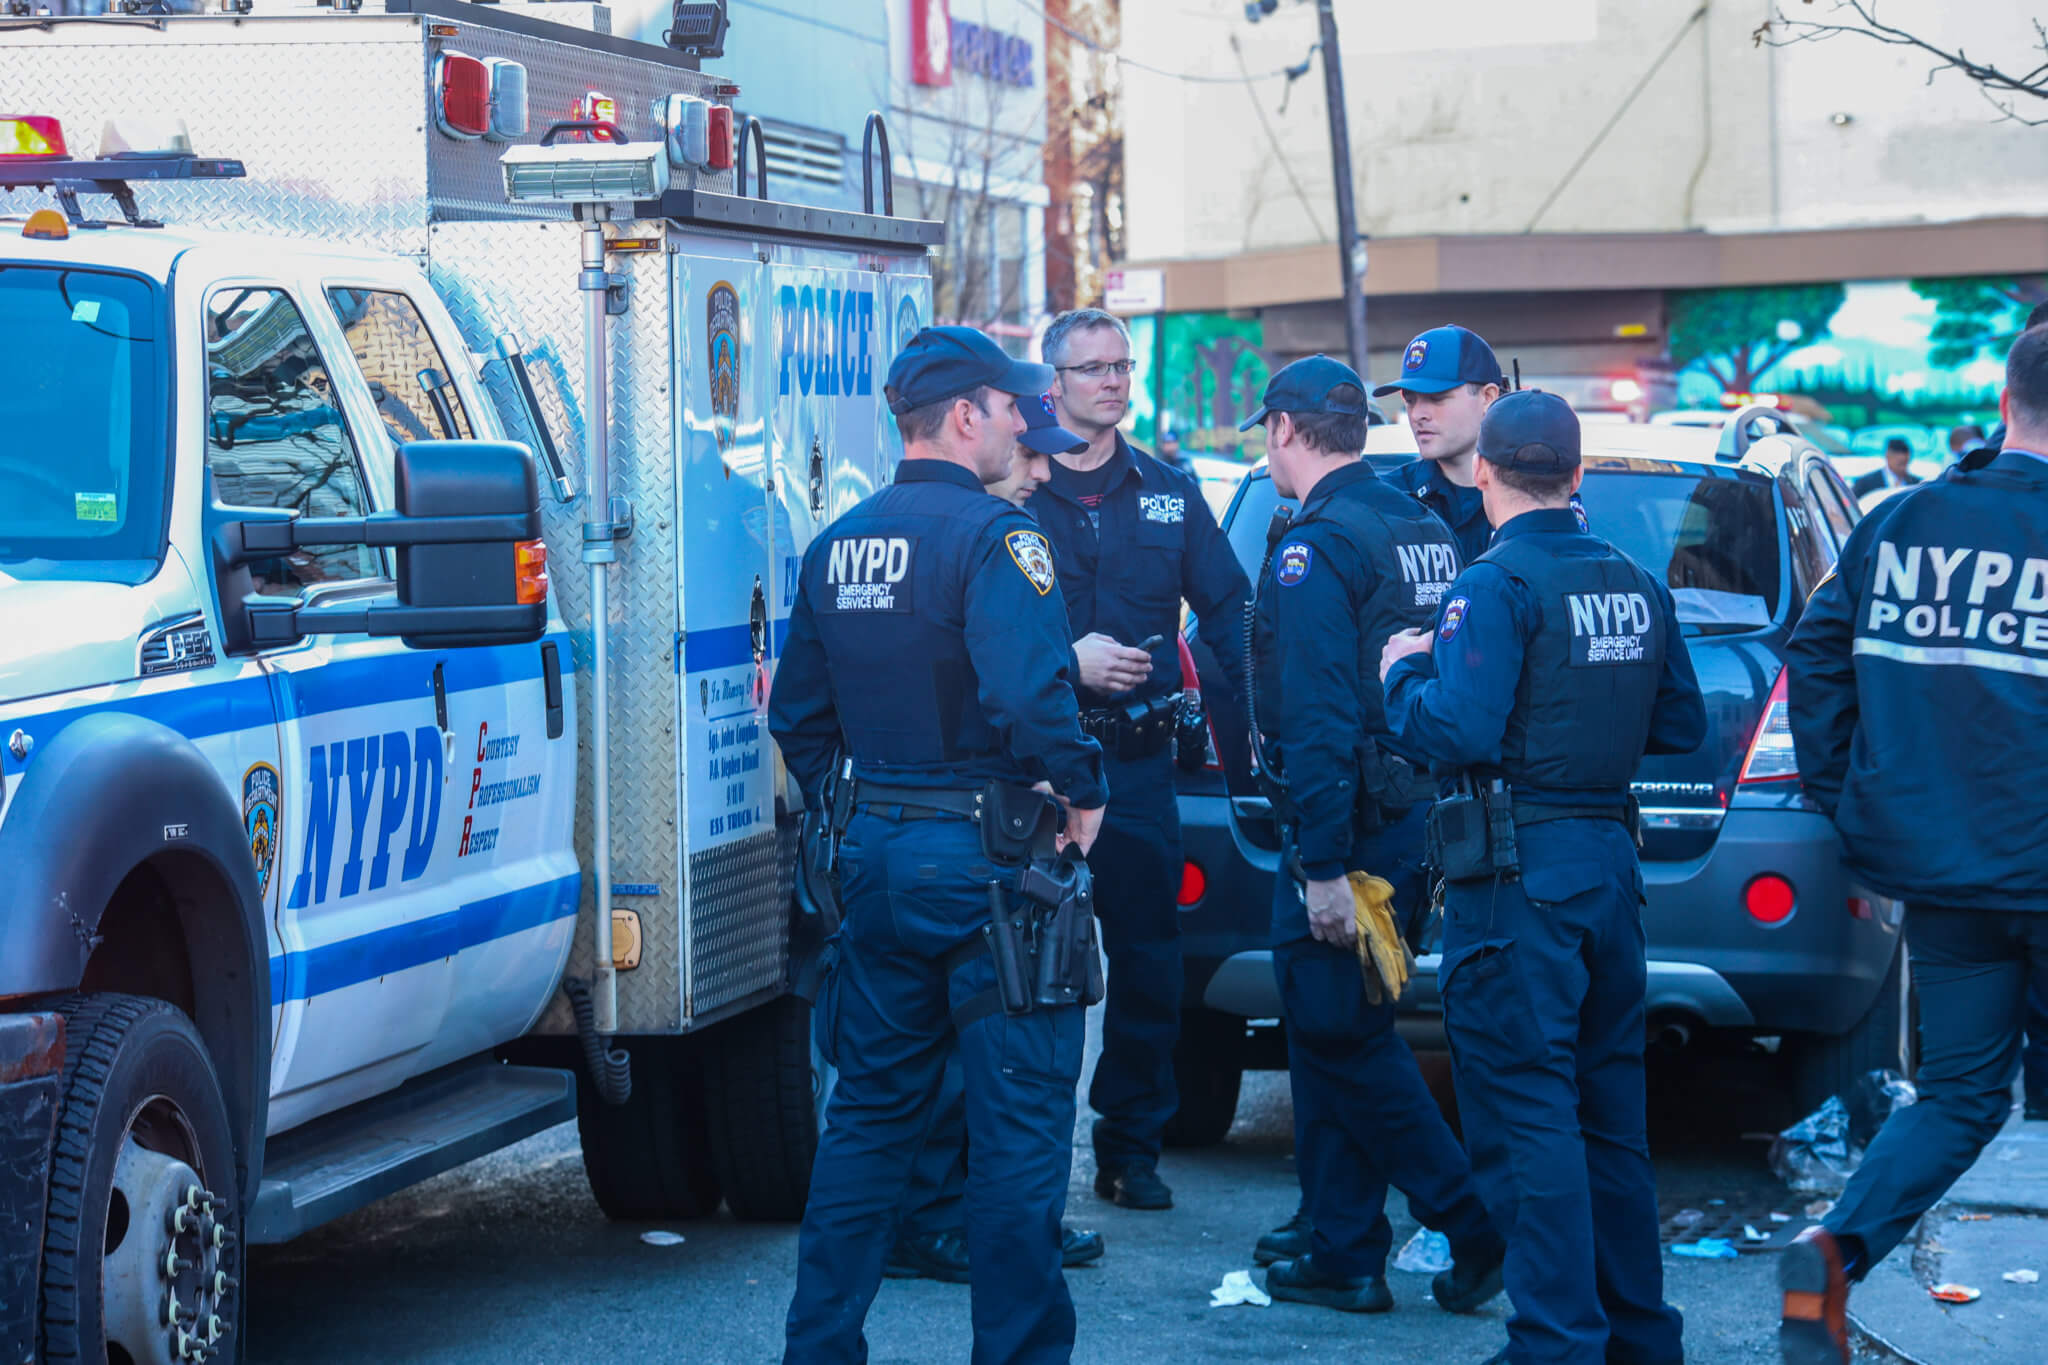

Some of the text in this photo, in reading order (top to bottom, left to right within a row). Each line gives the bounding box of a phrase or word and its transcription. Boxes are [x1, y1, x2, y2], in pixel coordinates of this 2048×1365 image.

[779, 285, 873, 397] POLICE
[1139, 496, 1184, 512] POLICE
[827, 538, 909, 584] NYPD
[1396, 543, 1457, 583] NYPD
[1873, 540, 2048, 613] NYPD
[836, 595, 895, 610] SERVICE UNIT
[838, 583, 892, 597] EMERGENCY
[1568, 592, 1651, 637] NYPD
[1867, 599, 2048, 650] POLICE
[1588, 647, 1644, 662] SERVICE UNIT
[1590, 635, 1641, 649] EMERGENCY
[251, 769, 271, 792] POLICE
[245, 785, 278, 817] DEPARTMENT
[287, 725, 443, 910] NYPD
[710, 816, 725, 836] ESS
[727, 808, 753, 831] TRUCK
